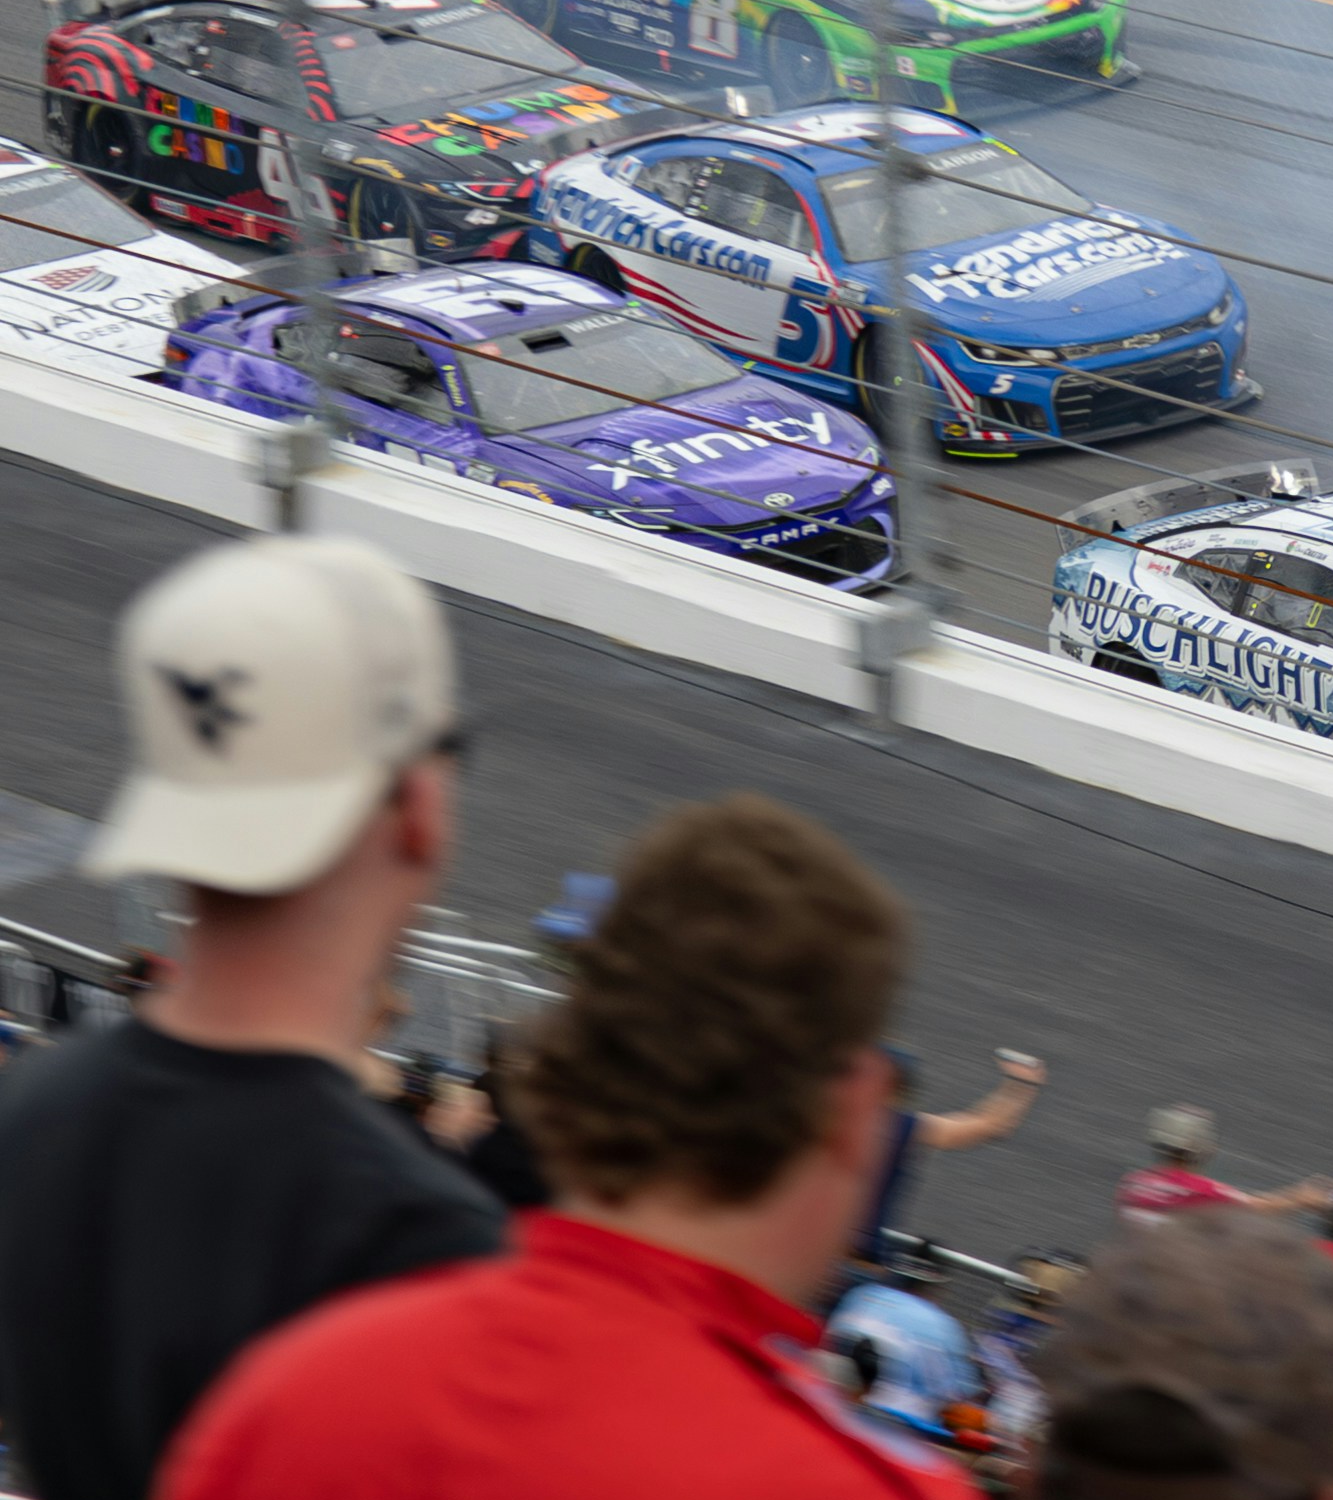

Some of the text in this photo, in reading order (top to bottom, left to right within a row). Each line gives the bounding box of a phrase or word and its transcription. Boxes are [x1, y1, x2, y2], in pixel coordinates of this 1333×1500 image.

[928, 147, 1000, 171] LARSON
[906, 212, 1142, 303] Hendrick
[774, 275, 837, 373] 5
[989, 373, 1017, 394] 5
[586, 411, 832, 491] xfinity
[1080, 571, 1333, 713] BUSCH LIGHT
